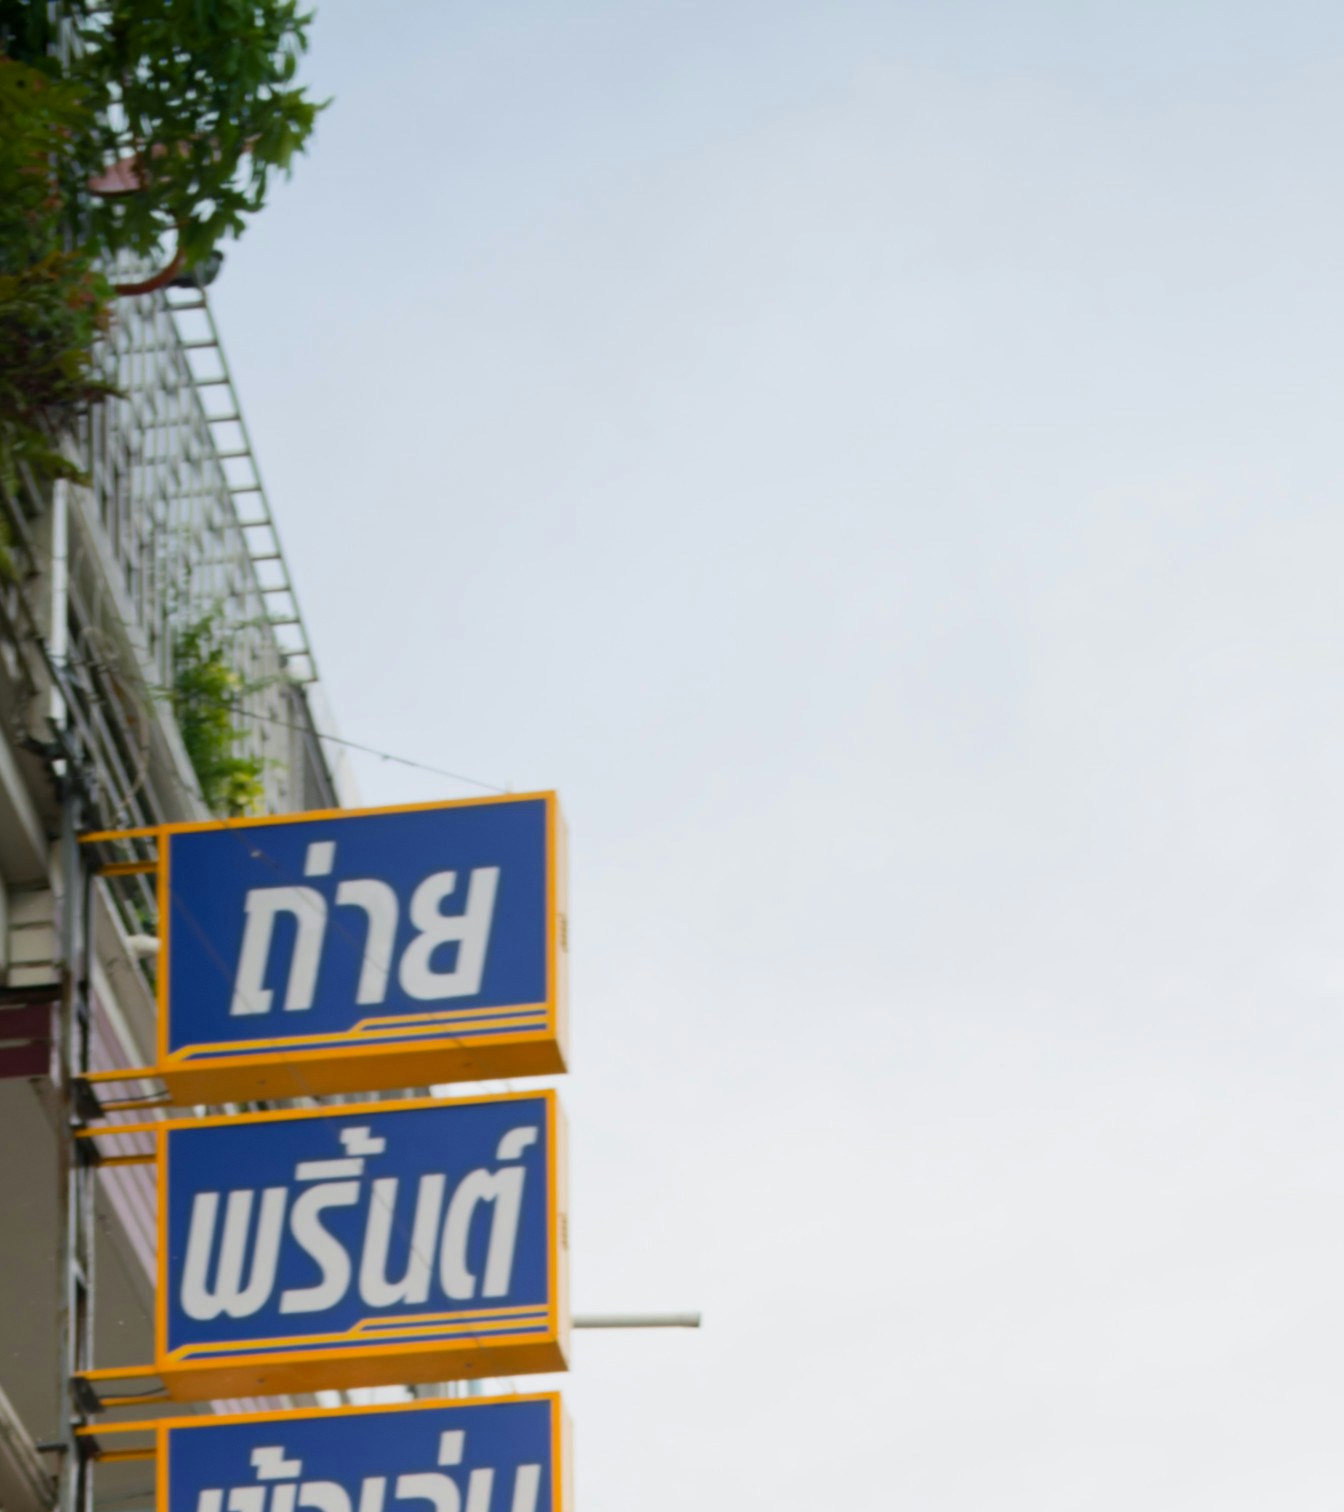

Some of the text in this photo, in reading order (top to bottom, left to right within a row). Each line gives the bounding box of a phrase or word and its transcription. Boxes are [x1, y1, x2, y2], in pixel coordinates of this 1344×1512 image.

[230, 841, 499, 1015] ถ่าย
[181, 1126, 537, 1321] พริ้นต์
